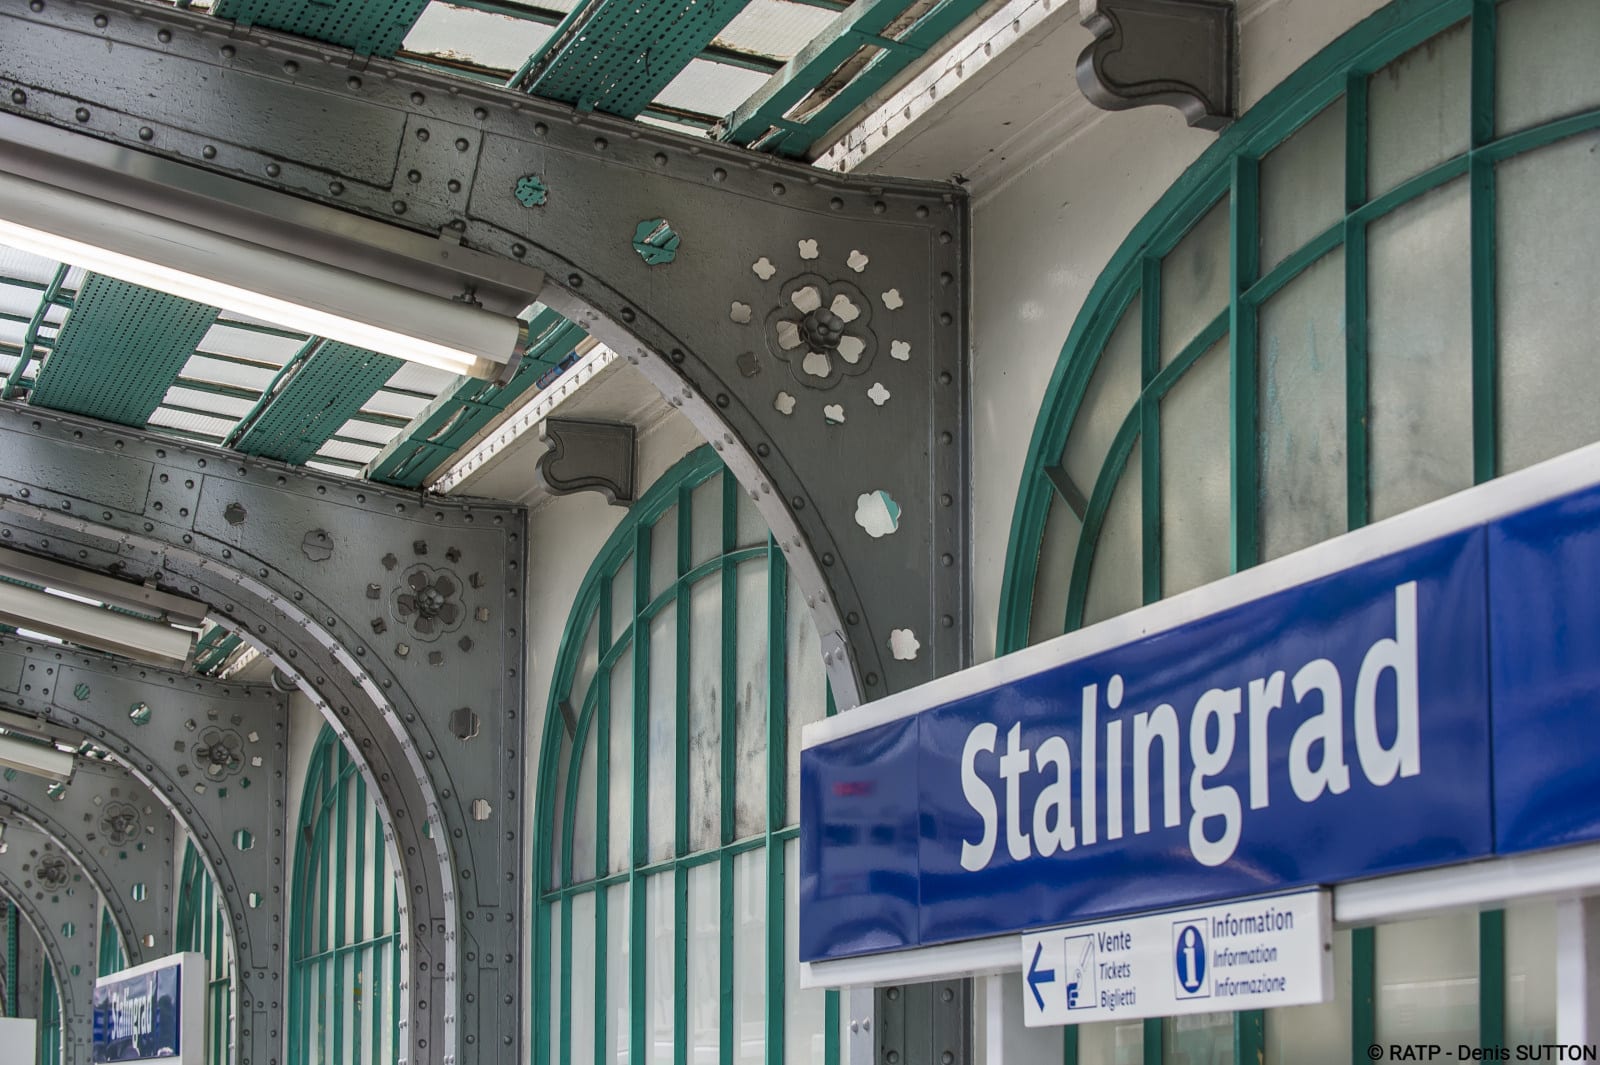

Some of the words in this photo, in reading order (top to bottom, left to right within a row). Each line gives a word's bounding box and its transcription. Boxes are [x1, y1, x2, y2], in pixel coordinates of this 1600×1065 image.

[960, 581, 1421, 871] Stalingrad
[1212, 907, 1294, 938] Information
[1098, 931, 1132, 952] Vente
[1213, 944, 1278, 968] Information
[1099, 962, 1131, 981] Tickets
[1214, 974, 1286, 997] Informazione
[1101, 987, 1136, 1012] Biglietti
[111, 980, 153, 1049] Stalingrad
